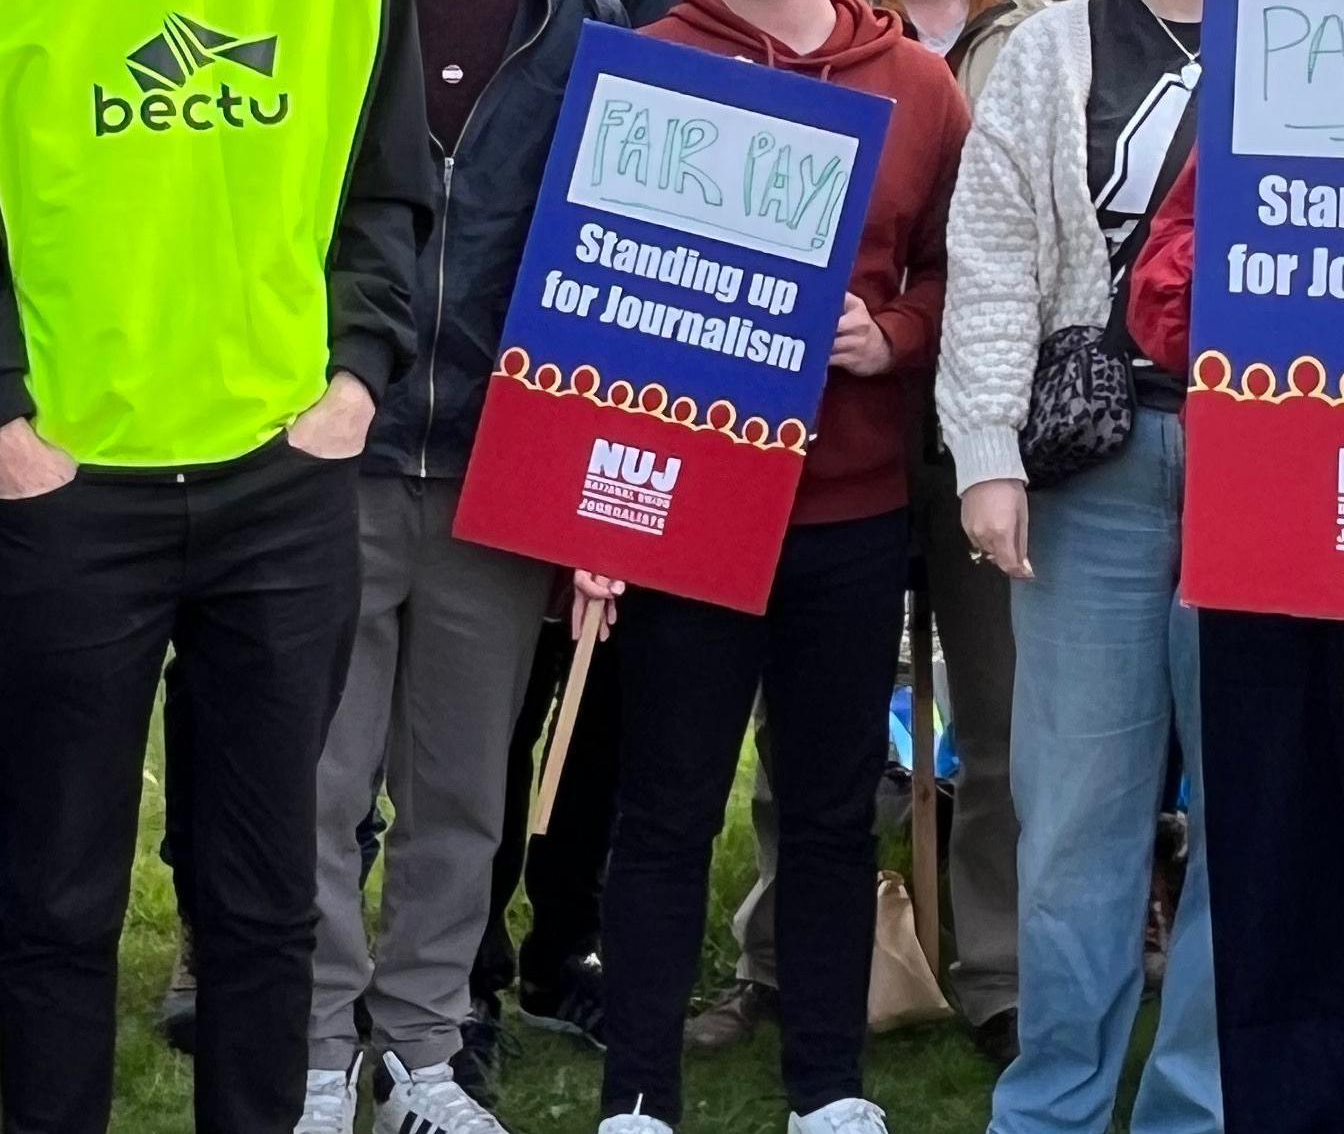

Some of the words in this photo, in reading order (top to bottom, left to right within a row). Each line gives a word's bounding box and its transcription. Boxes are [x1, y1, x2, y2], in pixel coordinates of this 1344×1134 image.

[94, 83, 288, 137] bectu
[591, 99, 723, 206] FAIR
[743, 131, 848, 249] PAY!
[576, 223, 744, 303] Standing
[747, 273, 799, 316] up
[1228, 243, 1298, 297] for
[541, 270, 599, 317] for
[599, 285, 806, 372] Journalism
[588, 438, 682, 493] NUJ
